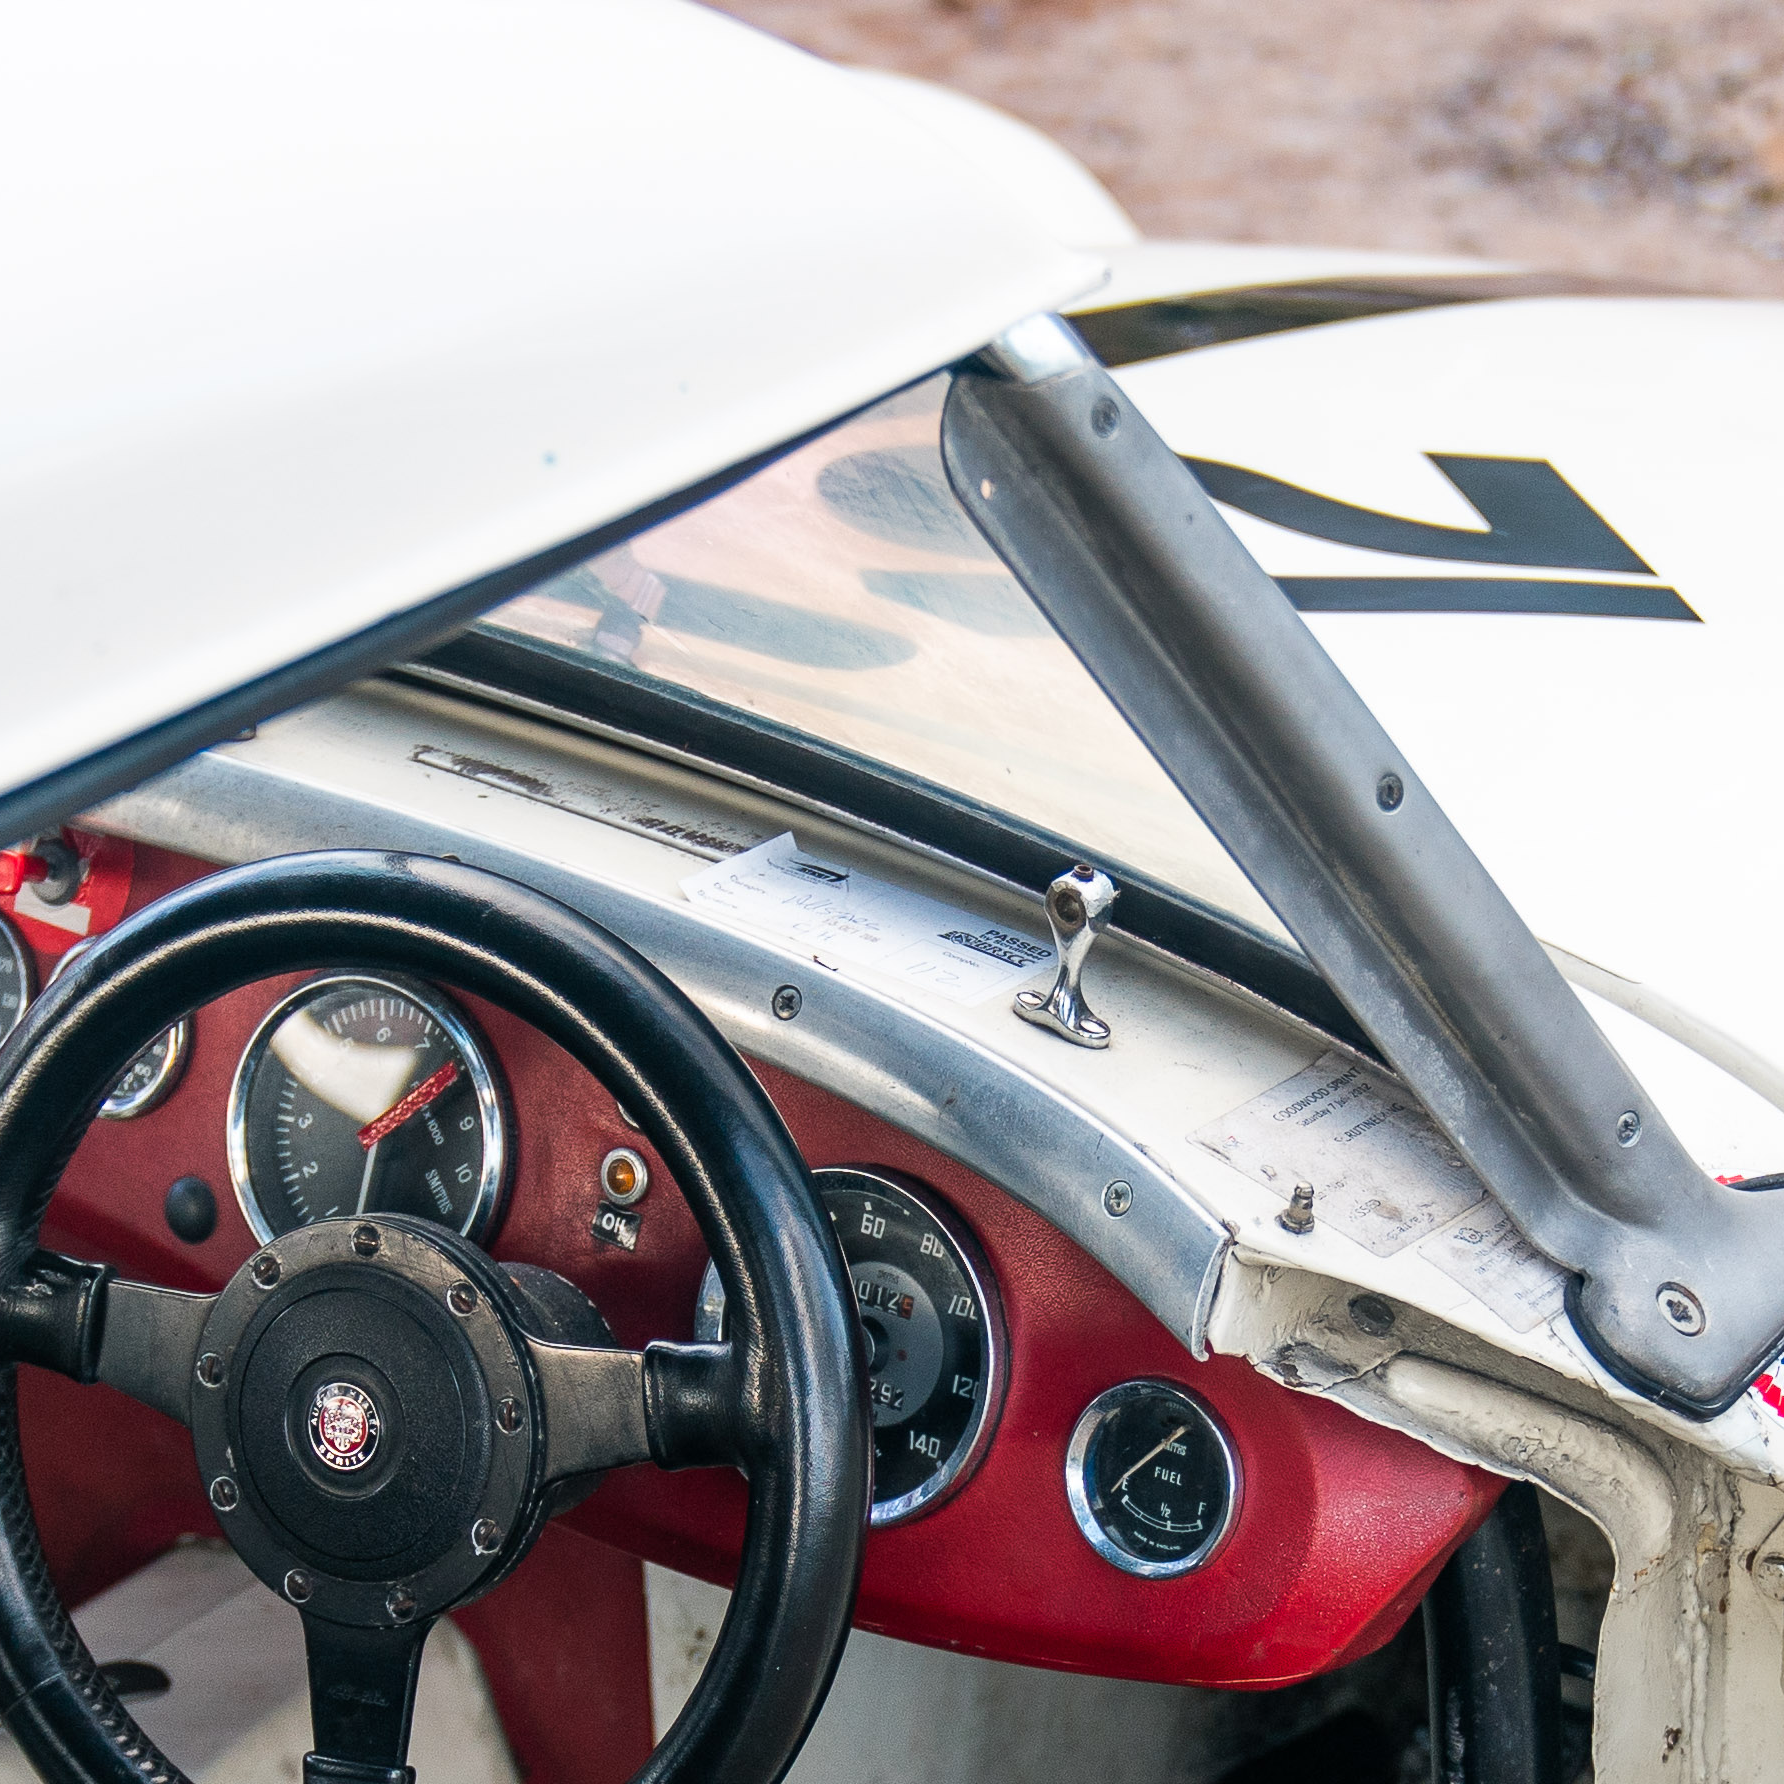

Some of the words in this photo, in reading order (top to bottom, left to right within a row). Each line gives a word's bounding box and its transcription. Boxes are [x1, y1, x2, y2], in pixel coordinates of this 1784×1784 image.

[985, 929, 1052, 958] PASSED
[376, 1027, 392, 1042] 6
[414, 1037, 431, 1051] 7
[298, 1112, 313, 1130] 3
[459, 1116, 474, 1131] 9
[427, 1119, 445, 1146] 1000
[301, 1162, 319, 1178] 2
[455, 1162, 473, 1184] 10
[425, 1168, 454, 1215] SMITHS
[861, 1213, 886, 1239] 60
[920, 1232, 945, 1258] 80
[319, 1444, 366, 1466] SPRITE
[909, 1430, 941, 1459] 140
[1121, 1477, 1129, 1491] E
[1154, 1466, 1182, 1486] FUEL
[1197, 1501, 1206, 1516] F
